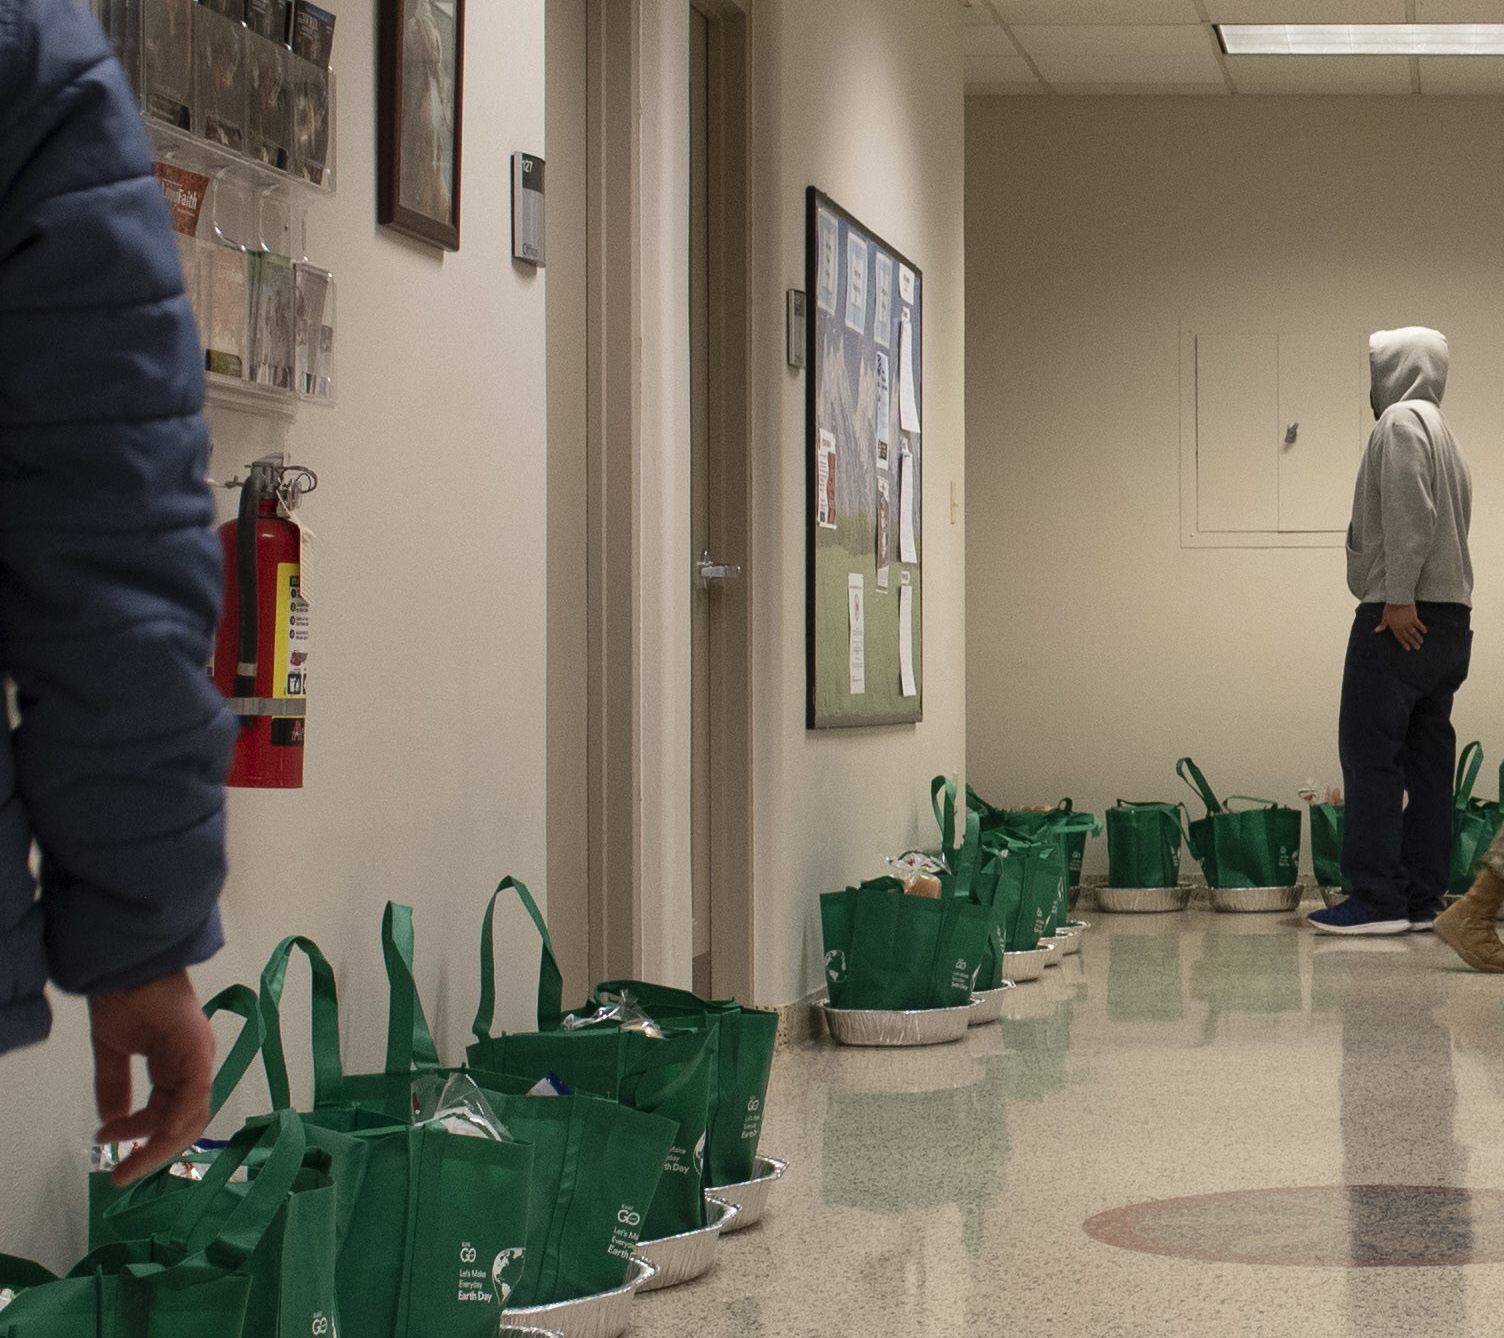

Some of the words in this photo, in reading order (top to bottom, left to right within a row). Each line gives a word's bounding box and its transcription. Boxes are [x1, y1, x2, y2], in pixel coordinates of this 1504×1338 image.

[672, 1162, 690, 1175] Day
[617, 1209, 641, 1227] GO
[613, 1226, 629, 1239] Let's
[459, 1247, 477, 1263] GO
[607, 1243, 630, 1261] Earth
[459, 1268, 471, 1279] Let's
[471, 1268, 487, 1279] Make
[458, 1279, 483, 1290] Everyday
[457, 1290, 477, 1301] Earth
[477, 1290, 493, 1304] Day
